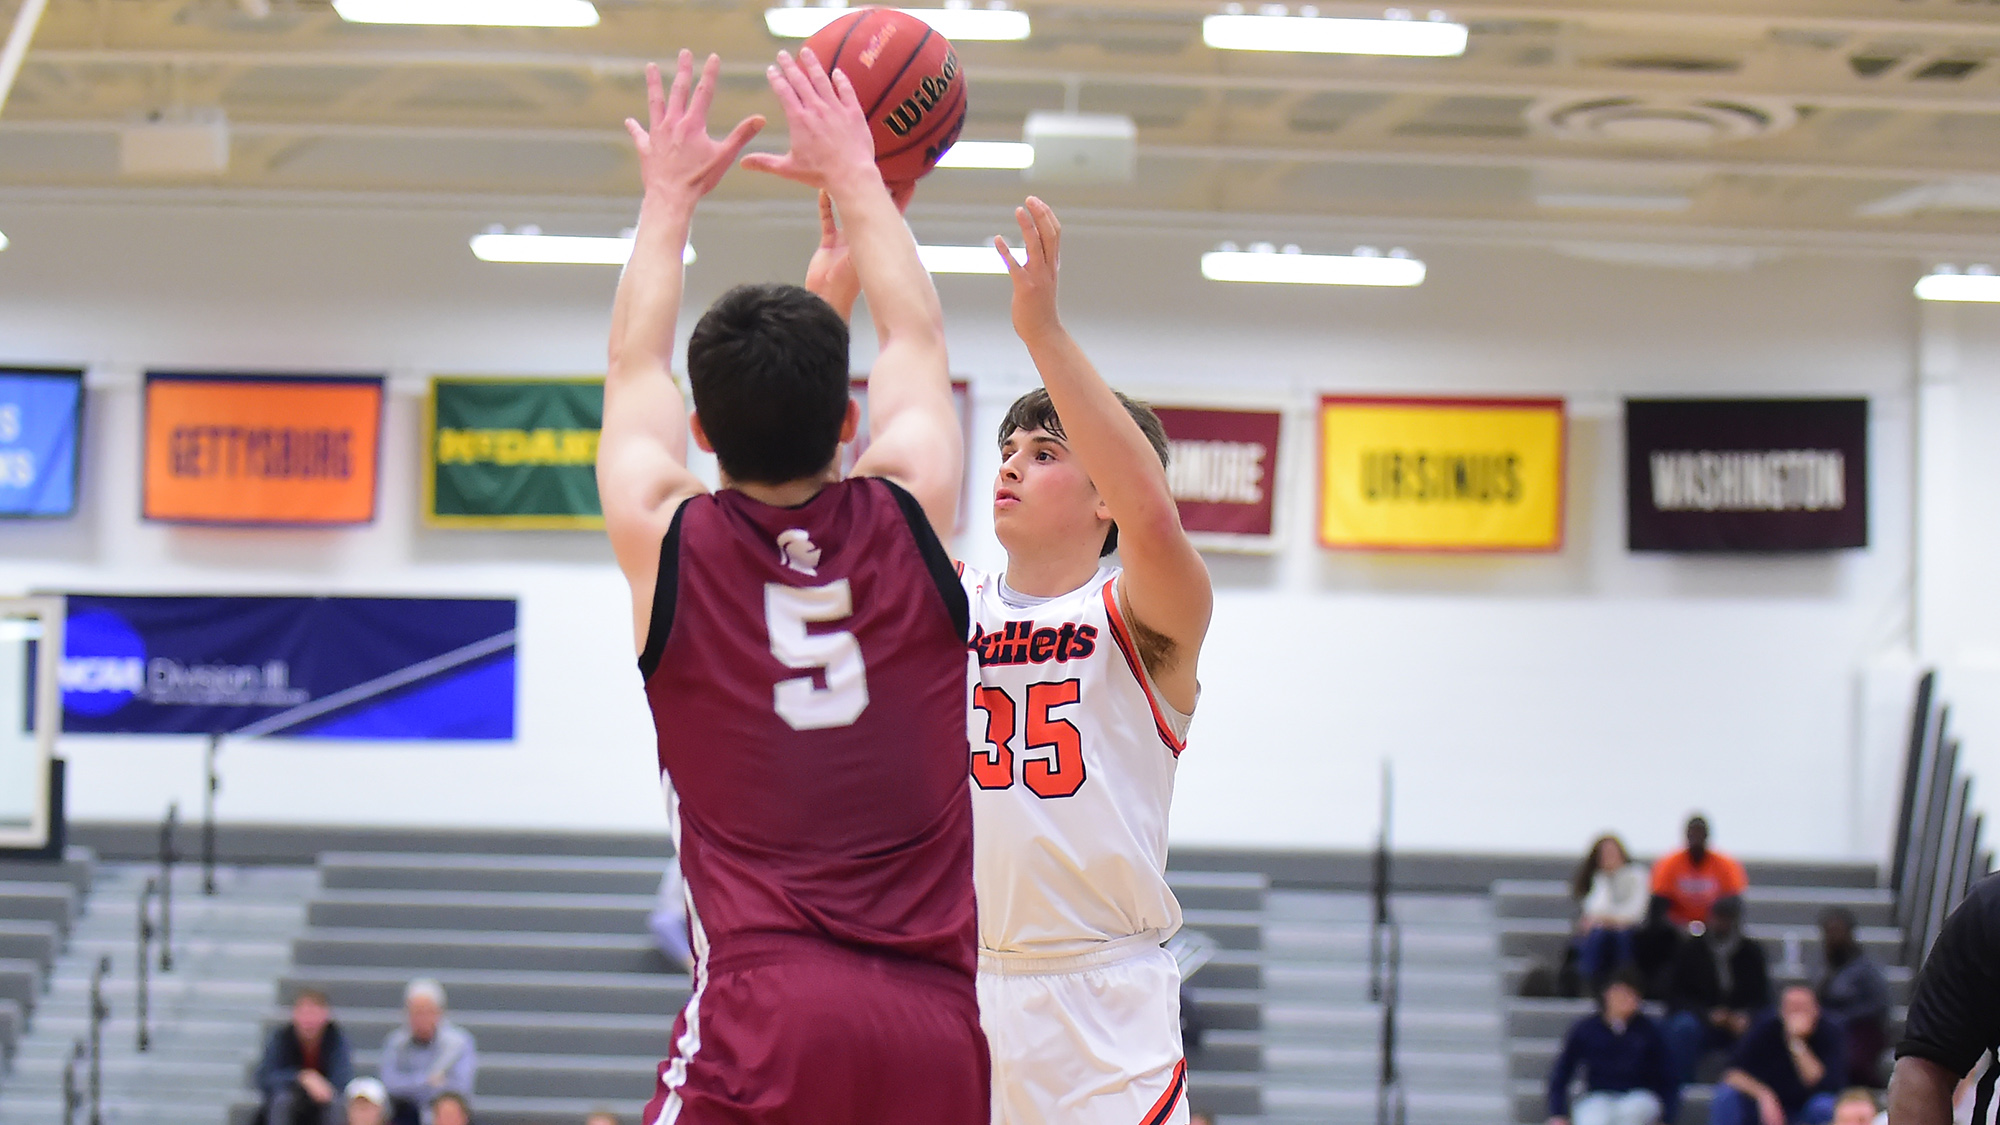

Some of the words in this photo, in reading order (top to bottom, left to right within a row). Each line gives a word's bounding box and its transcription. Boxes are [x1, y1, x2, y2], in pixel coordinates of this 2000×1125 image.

[881, 48, 958, 138] Wilson
[168, 424, 354, 480] GETTYSBURG
[1165, 439, 1267, 504] HMORE
[1360, 449, 1524, 505] URSINUS
[1649, 449, 1846, 511] WASHINGTON
[148, 657, 262, 696] Division
[764, 577, 870, 731] 5
[970, 677, 1087, 800] 35
